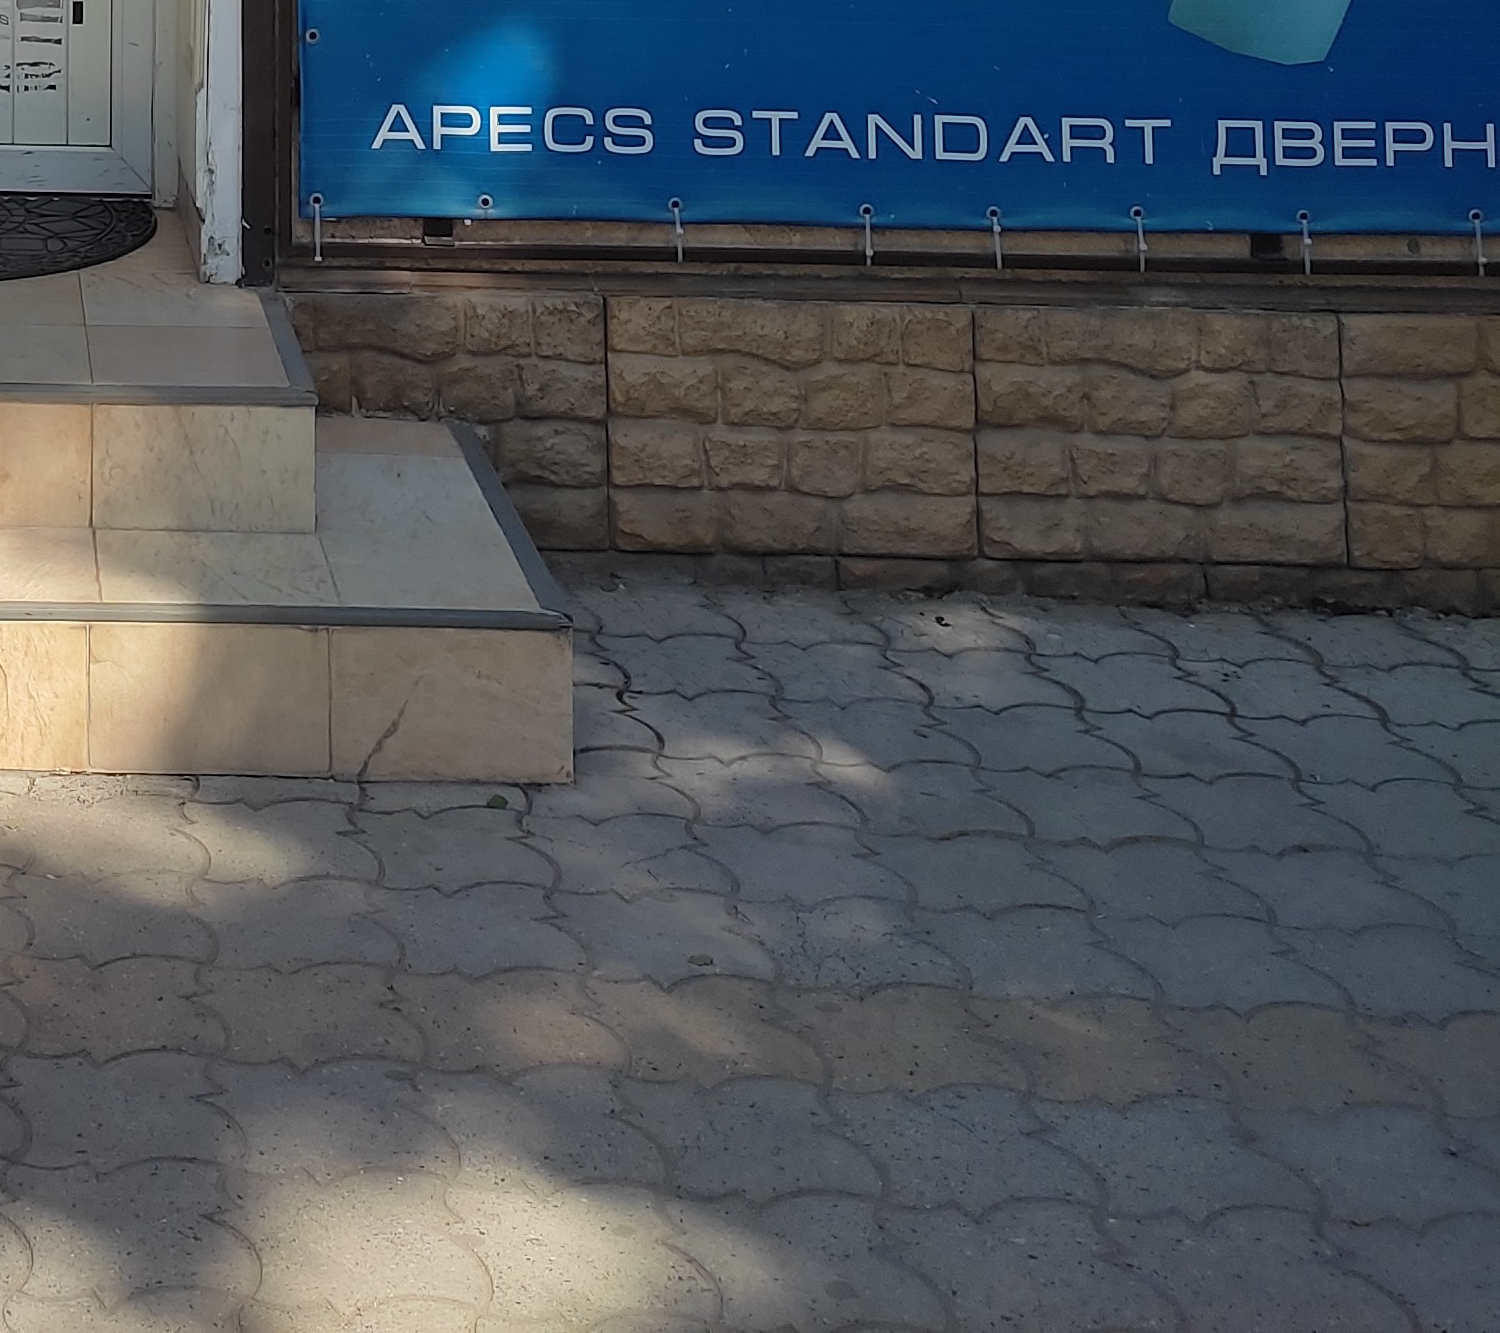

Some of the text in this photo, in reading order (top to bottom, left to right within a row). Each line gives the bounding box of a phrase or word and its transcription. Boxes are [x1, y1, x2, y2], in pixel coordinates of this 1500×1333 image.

[371, 103, 1496, 176] APECS STANDART ДВЕРН
